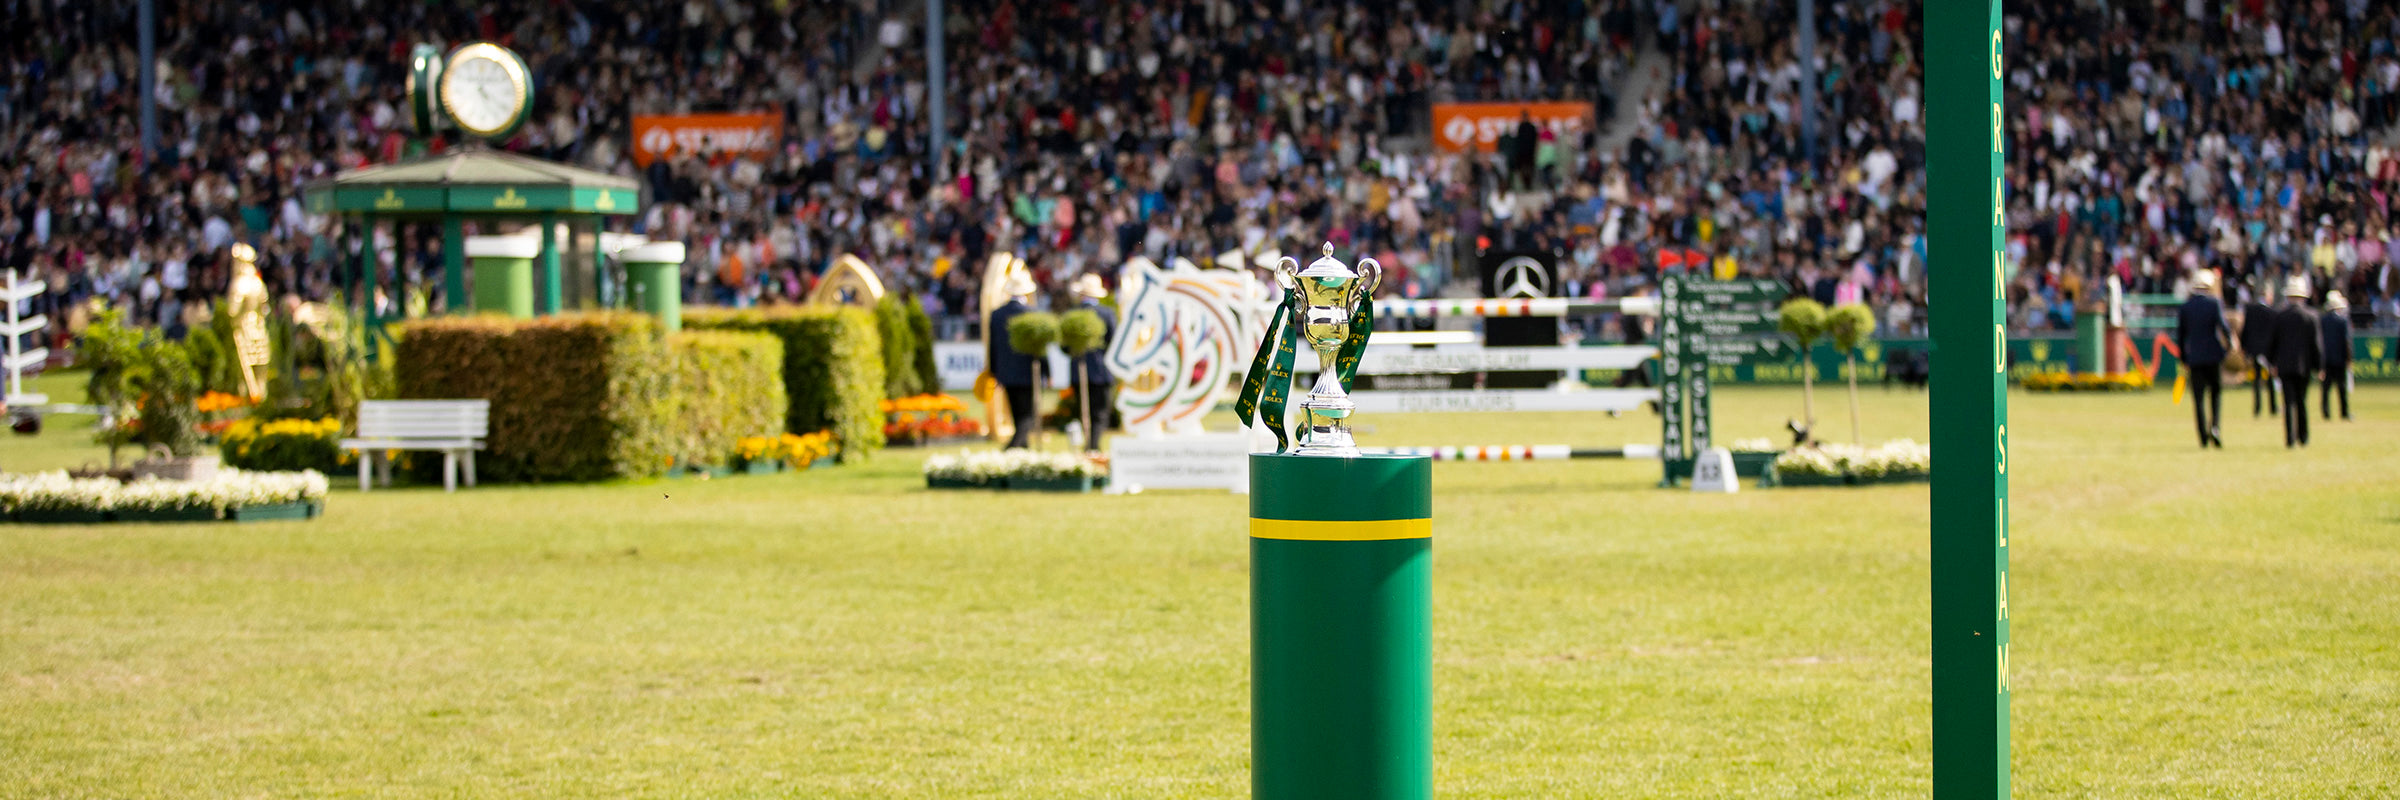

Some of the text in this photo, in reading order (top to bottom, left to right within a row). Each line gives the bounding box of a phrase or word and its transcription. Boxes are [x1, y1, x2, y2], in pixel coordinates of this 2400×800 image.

[1663, 276, 1682, 460] GRAND SLAM
[1991, 28, 2010, 695] GRAND SLAM
